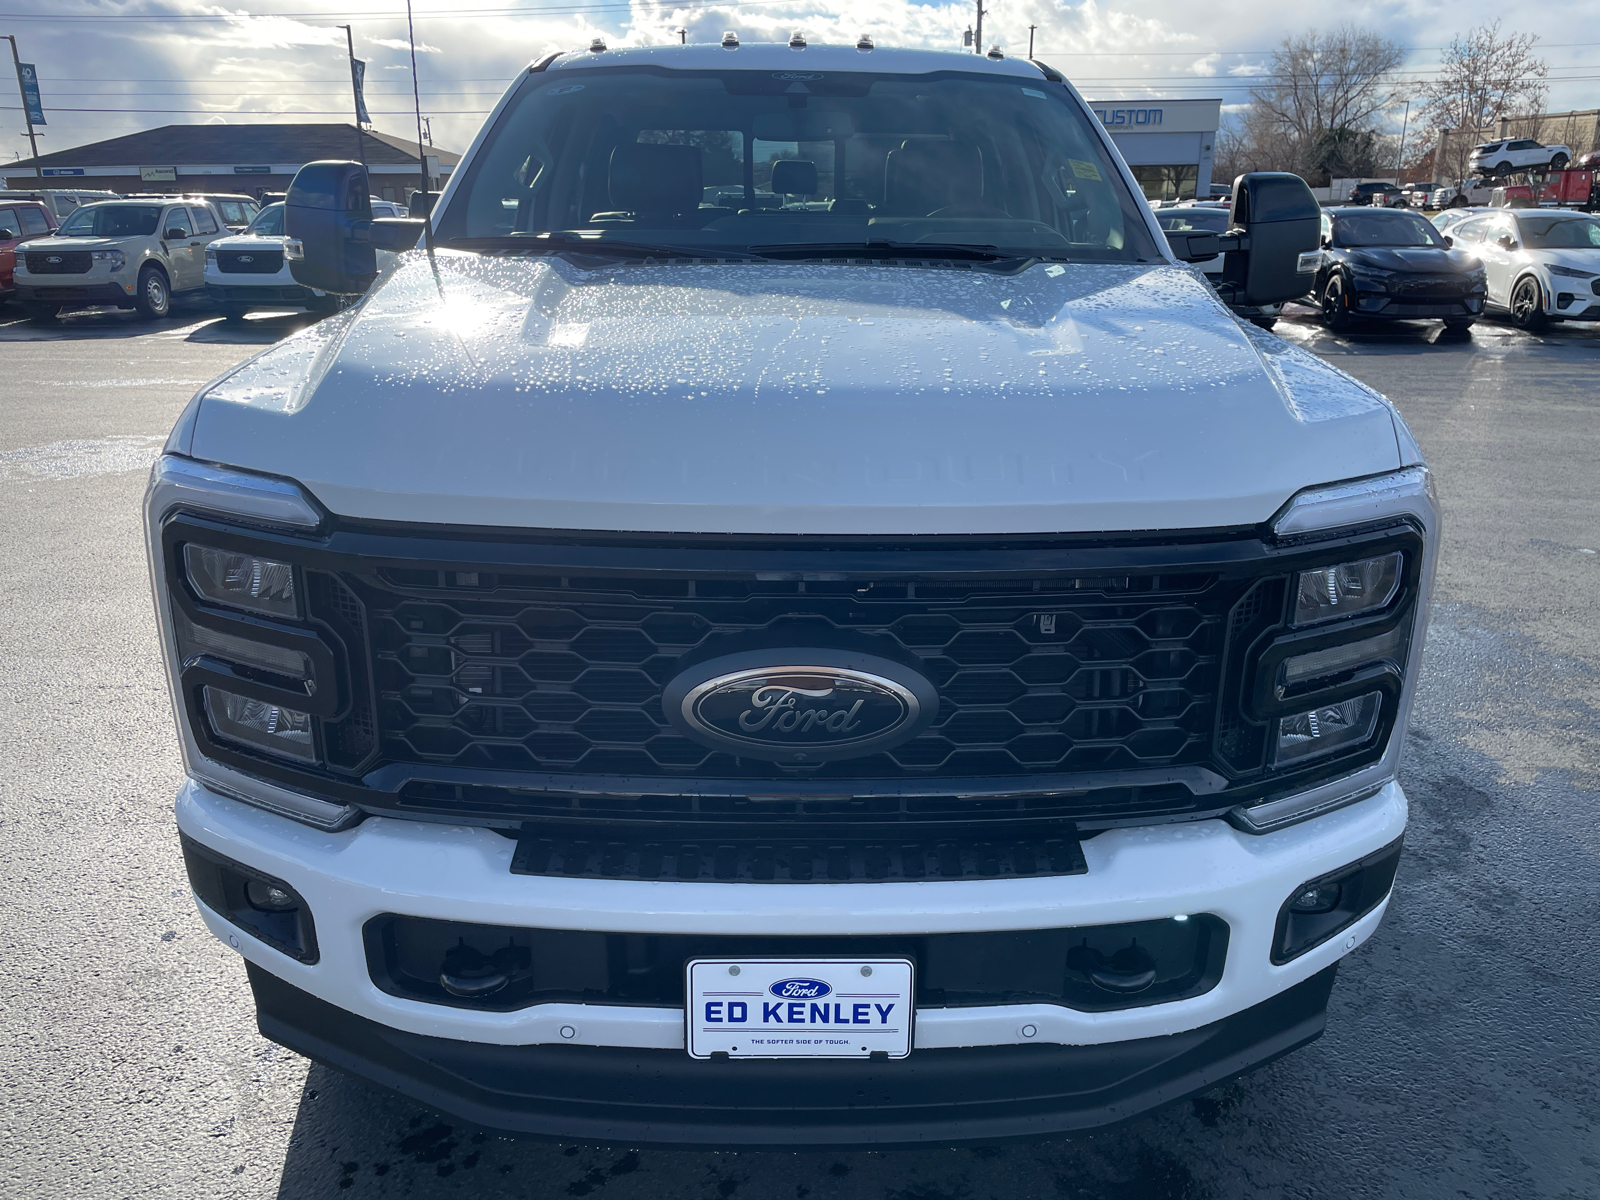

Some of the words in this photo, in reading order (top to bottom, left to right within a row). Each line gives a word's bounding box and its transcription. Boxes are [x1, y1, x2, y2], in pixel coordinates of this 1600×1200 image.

[738, 685, 864, 733] Ford
[782, 981, 819, 996] Ford
[705, 1001, 748, 1023] ED
[762, 1001, 895, 1024] KENLEY
